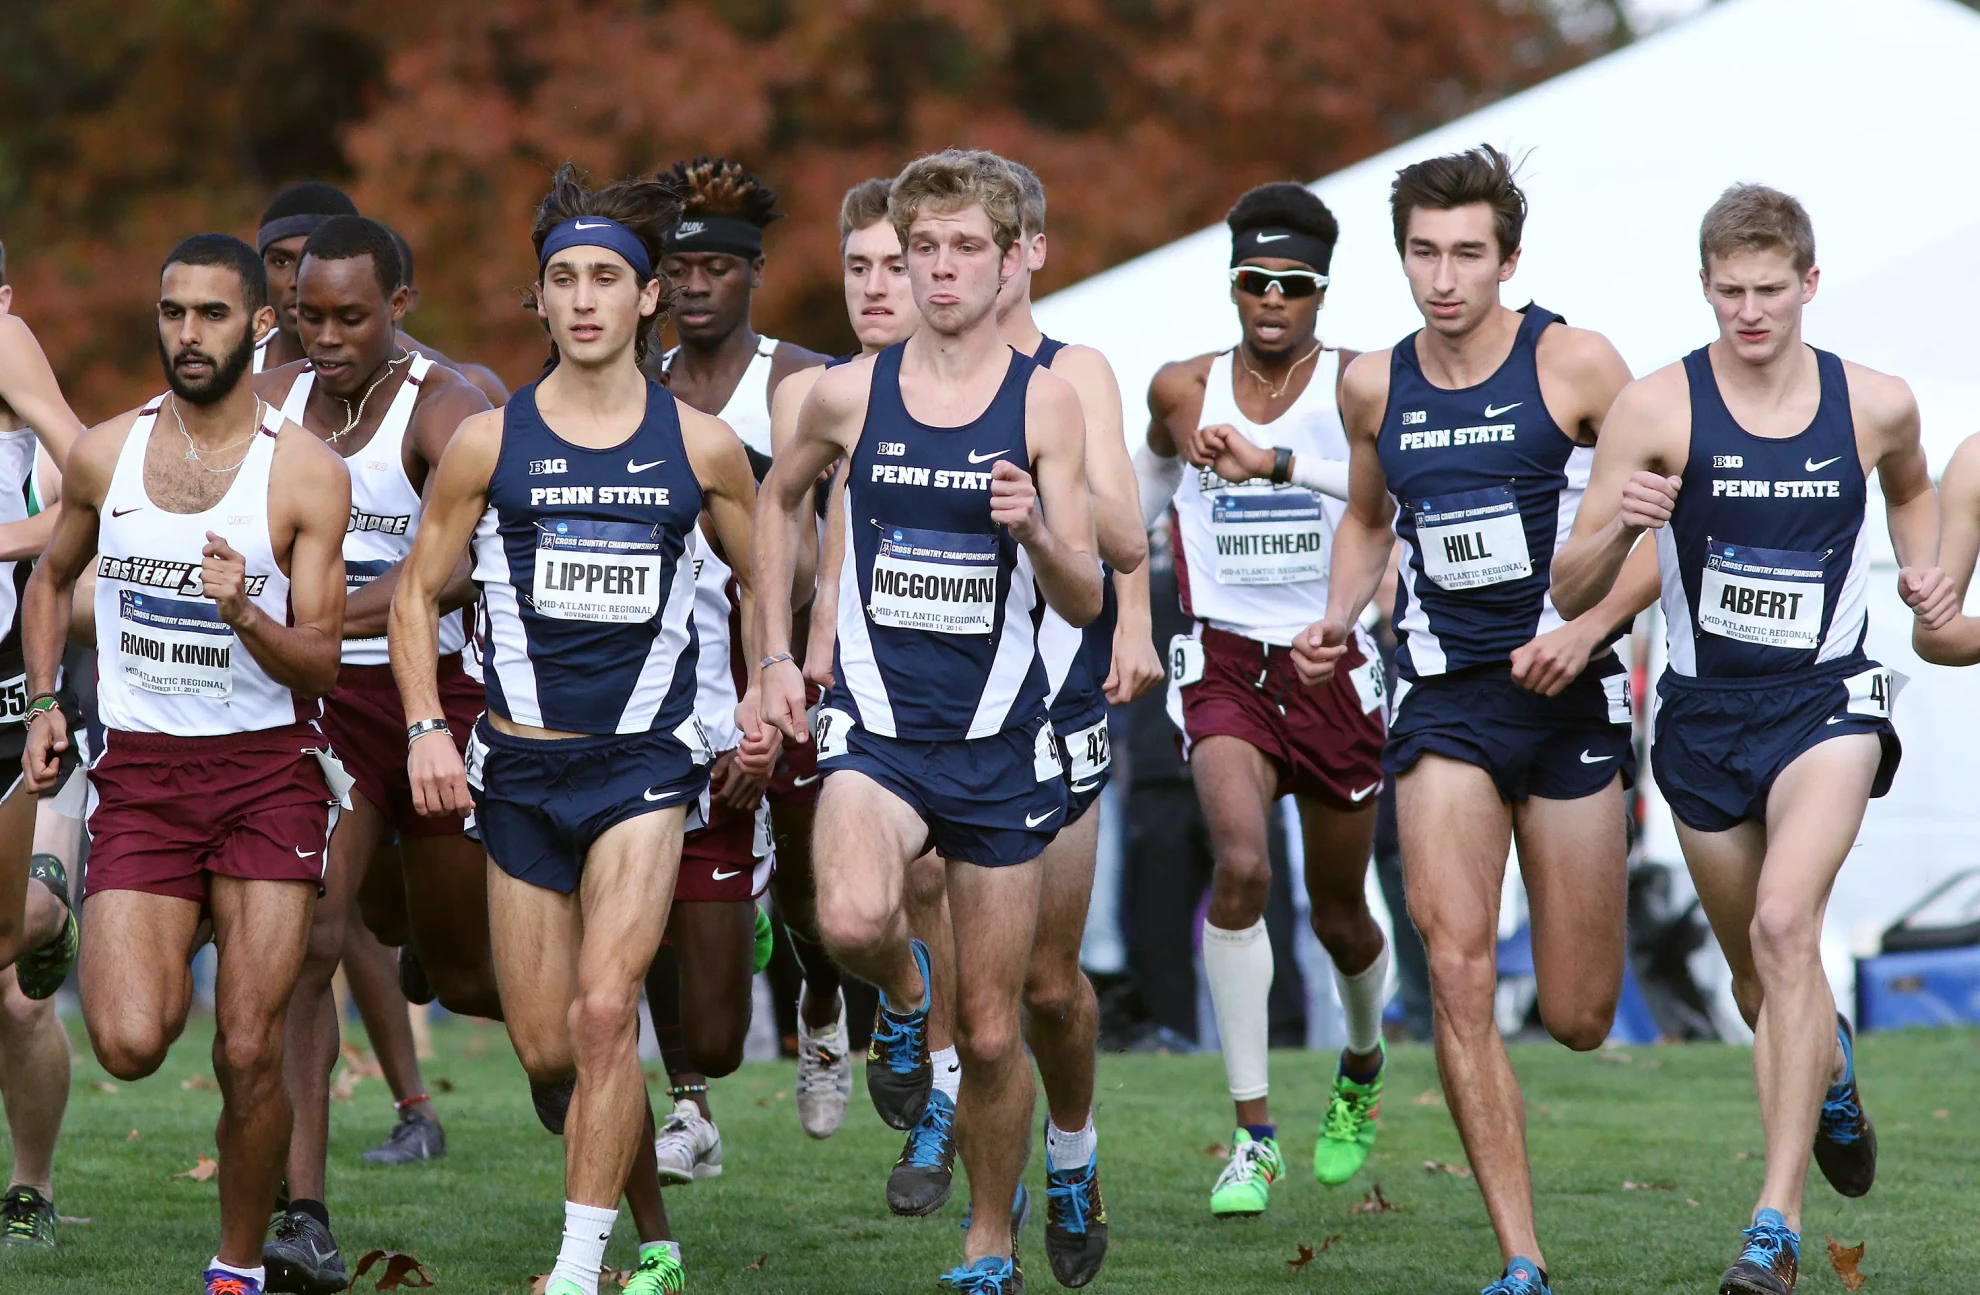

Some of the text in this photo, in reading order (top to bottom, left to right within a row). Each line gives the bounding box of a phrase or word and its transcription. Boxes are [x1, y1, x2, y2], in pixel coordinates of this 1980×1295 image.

[680, 222, 705, 231] RUN
[1400, 424, 1516, 451] PENN STATE
[871, 464, 993, 491] PENN STAT
[530, 486, 670, 506] PENN STATE
[1712, 480, 1840, 498] PENN STATE
[1425, 502, 1514, 522] CROSS COUNTRY CHAMPIONSHIPS
[554, 537, 577, 546] CROSS
[578, 539, 608, 548] COUNTRY
[607, 541, 660, 551] CHAMPIONSHIPS
[891, 544, 912, 555] CROSS
[912, 547, 942, 558] COUNTRY
[942, 550, 996, 561] CHAMPIONSHIPS
[1216, 532, 1321, 556] WHITEHEAD
[1443, 532, 1492, 563] HILL
[132, 557, 190, 570] MARYLAND
[1431, 562, 1524, 583] MID-ATLANTIC REGIONAL
[1721, 560, 1743, 570] CROSS
[1743, 564, 1773, 575] COUNTRY
[1773, 567, 1824, 578] CHAMPIONSHIPS
[99, 557, 268, 596] EASTERN SRE
[545, 561, 650, 595] LIPPERT
[874, 567, 994, 603] MCGOWAN
[539, 599, 652, 614] MID-ATLANTIC REGIONAL
[1720, 584, 1803, 620] ABERT
[133, 609, 231, 630] CROSS COUNTRY CHAMPIONSHIPS
[564, 611, 599, 620] NOVEMBER
[875, 606, 988, 625] MID-ATLANTIC REGIONAL
[898, 619, 934, 629] NOVEMBER
[1704, 614, 1813, 640] MID-ATLANTIC REGIONAL
[1726, 629, 1760, 642] NOVEMBER
[121, 631, 230, 669] RMIDI KININI
[125, 666, 224, 690] MID-ATLANTIC REGIONAL
[142, 682, 171, 692] NOVEMBER
